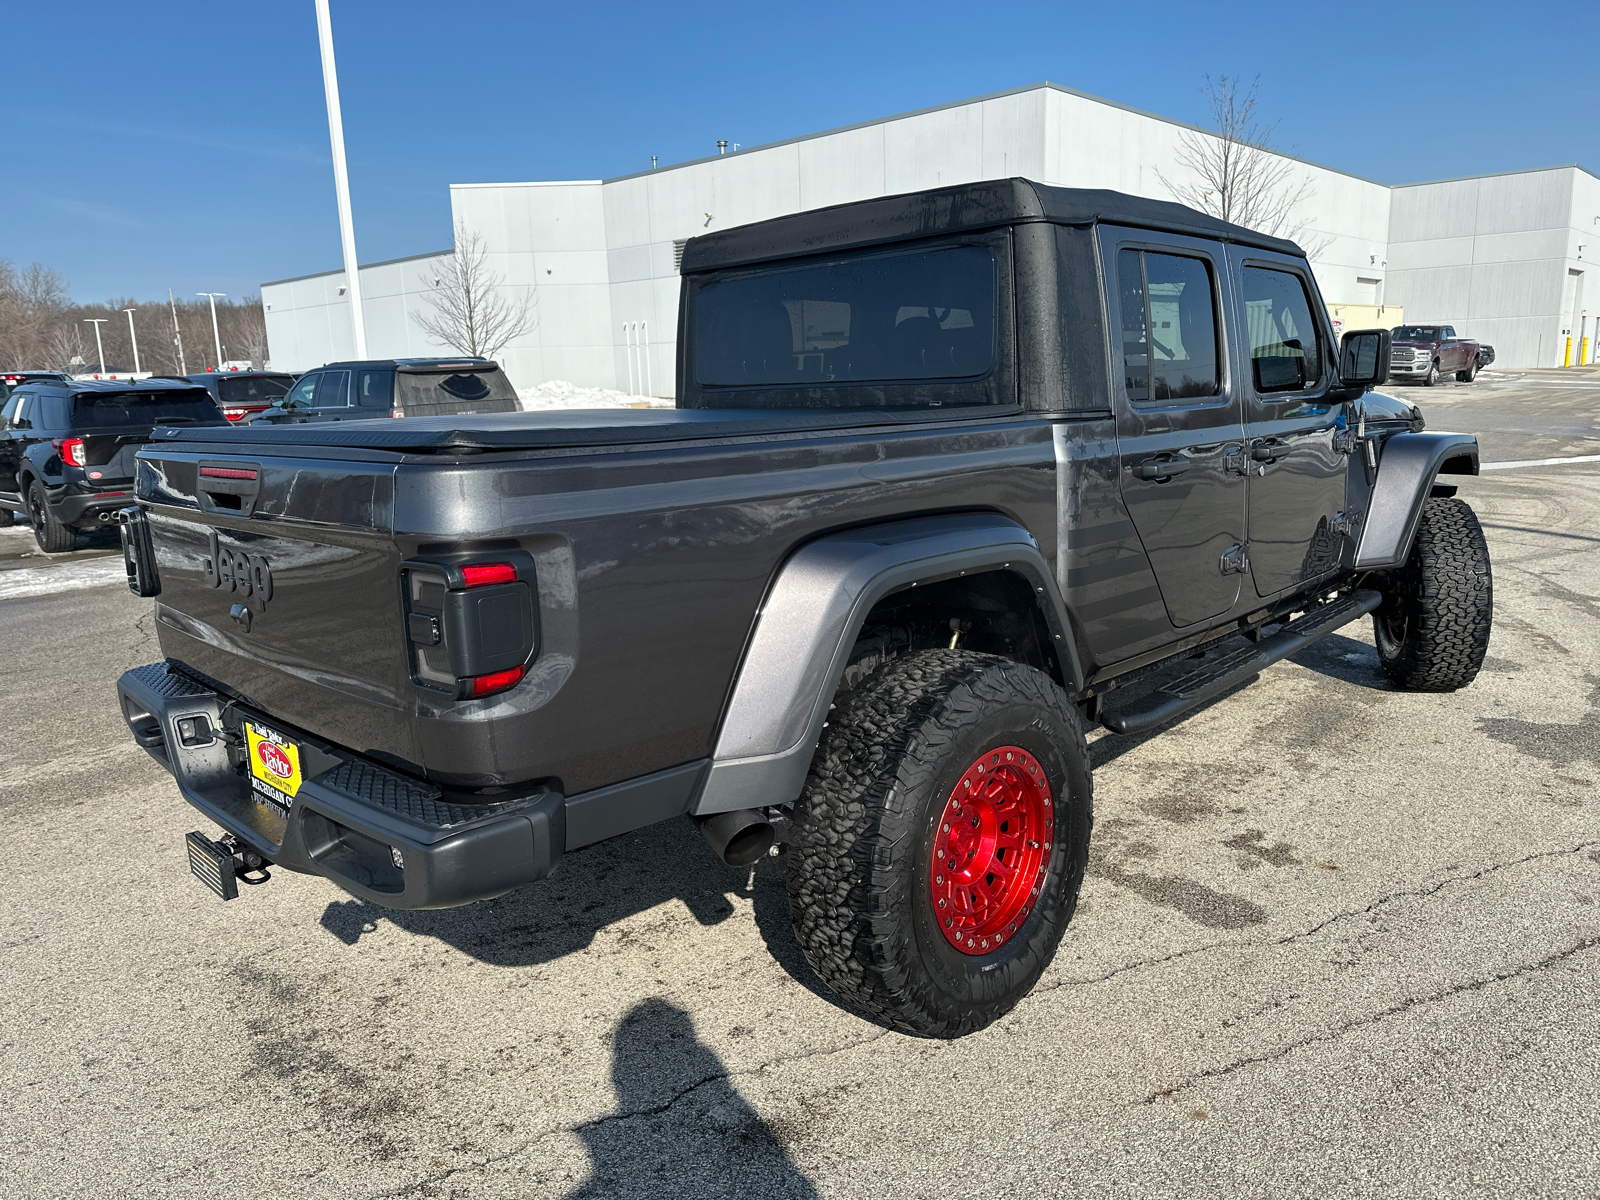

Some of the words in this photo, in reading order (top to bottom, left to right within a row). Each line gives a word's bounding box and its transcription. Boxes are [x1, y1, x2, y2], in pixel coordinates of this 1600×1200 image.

[203, 533, 273, 612] Jeep
[262, 750, 289, 777] Taylor
[251, 777, 285, 804] MICHIGAN
[263, 770, 283, 787] MICHIGAN
[282, 781, 292, 794] CITY
